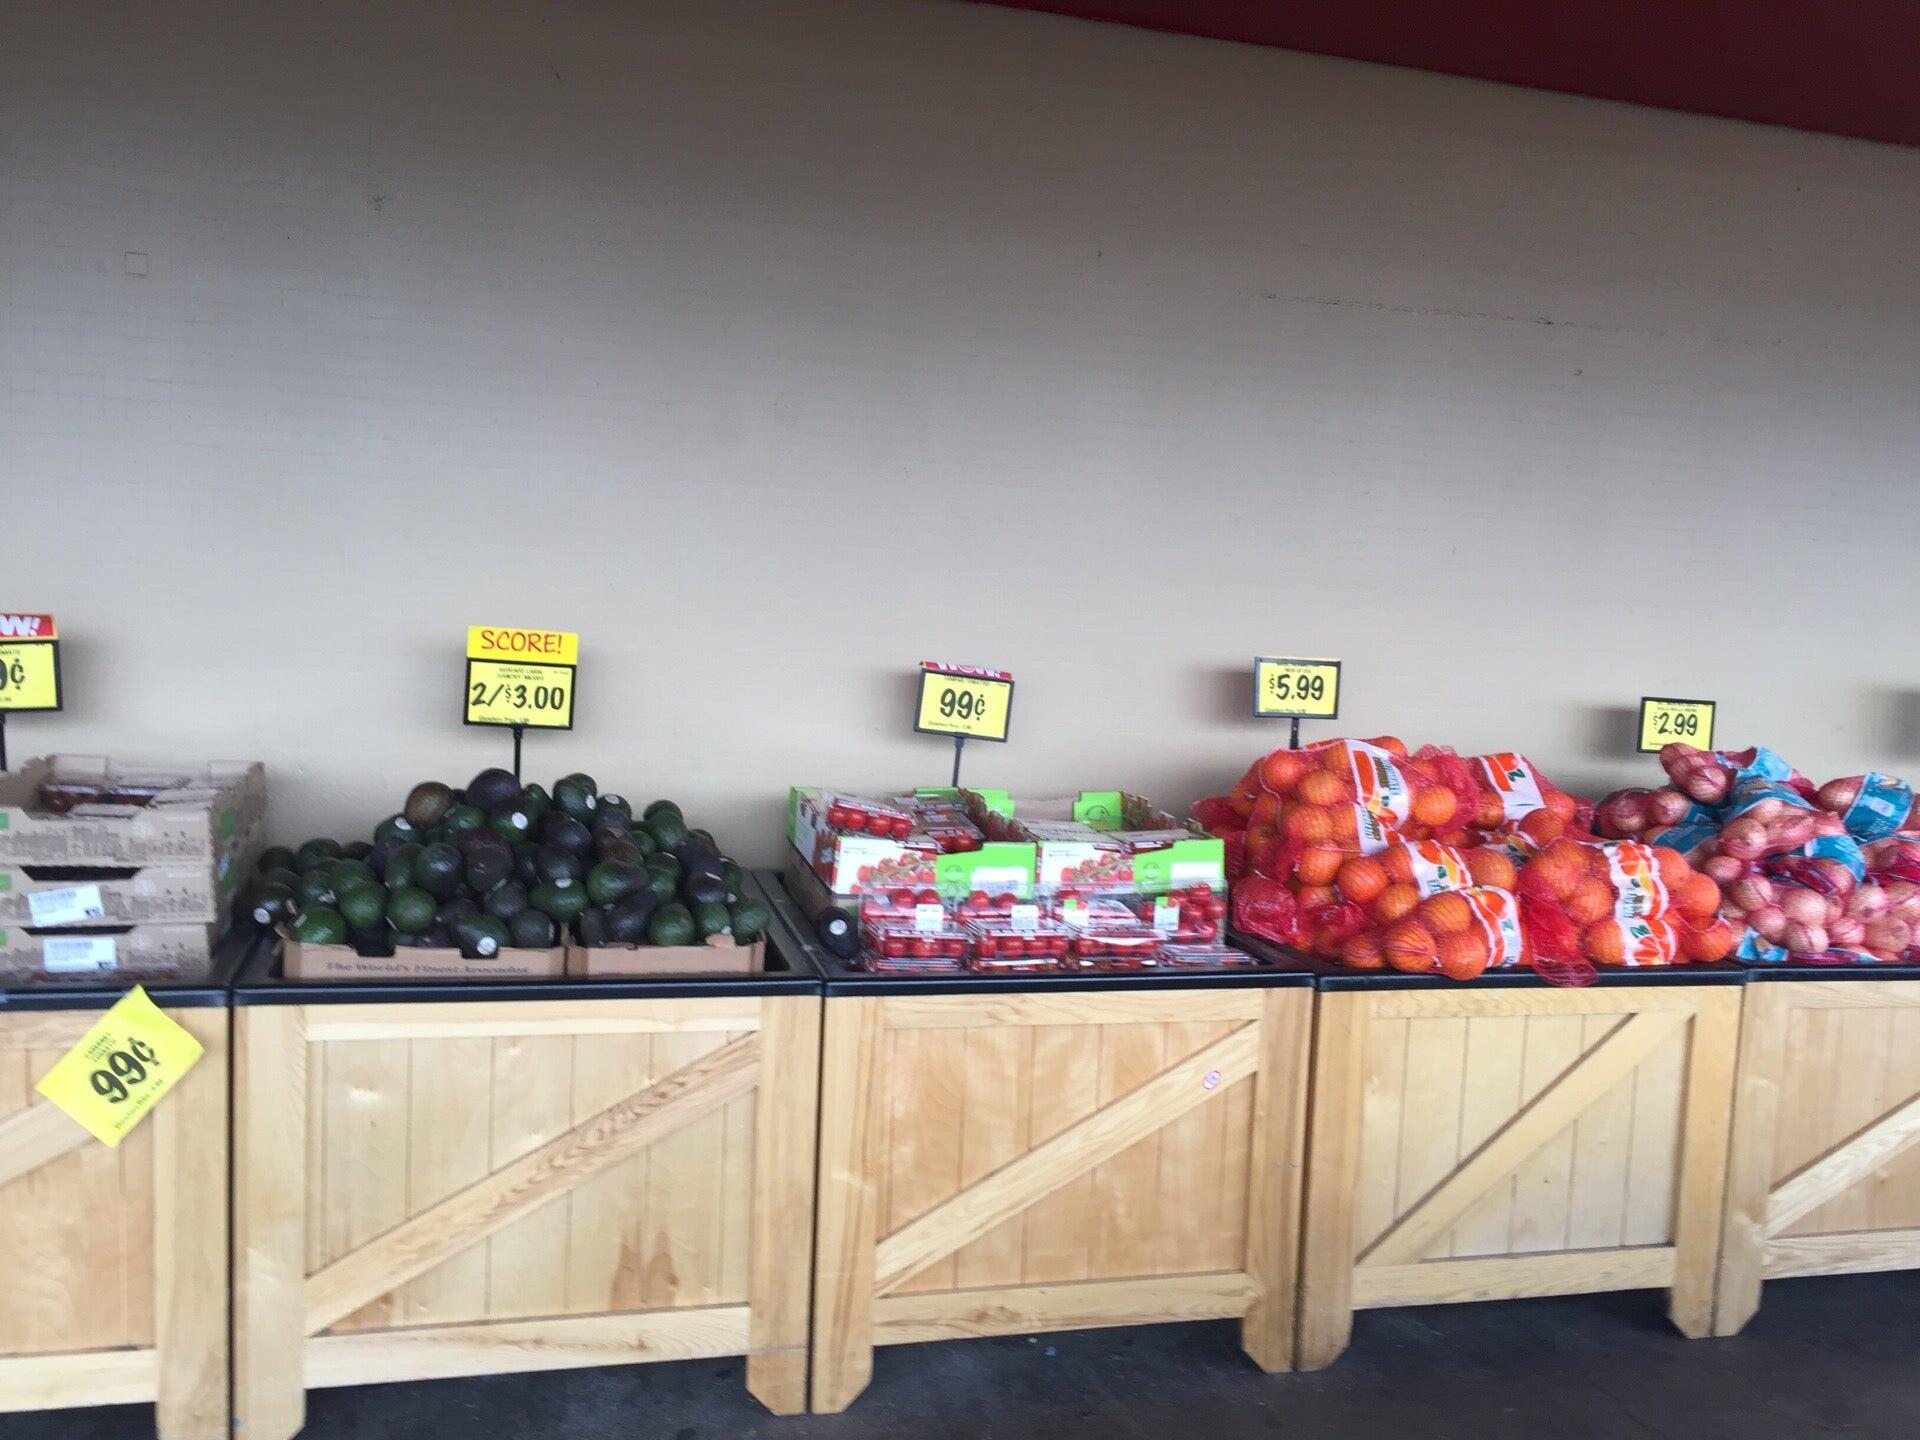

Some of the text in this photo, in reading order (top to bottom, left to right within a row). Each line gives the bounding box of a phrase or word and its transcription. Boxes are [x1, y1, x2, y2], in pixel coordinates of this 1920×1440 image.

[480, 629, 563, 655] SCORE!
[470, 682, 565, 711] 2/$3.00
[1268, 673, 1325, 701] $5.99
[939, 687, 986, 721] 99¢
[1653, 711, 1699, 737] $2.99
[90, 1036, 161, 1105] 99¢
